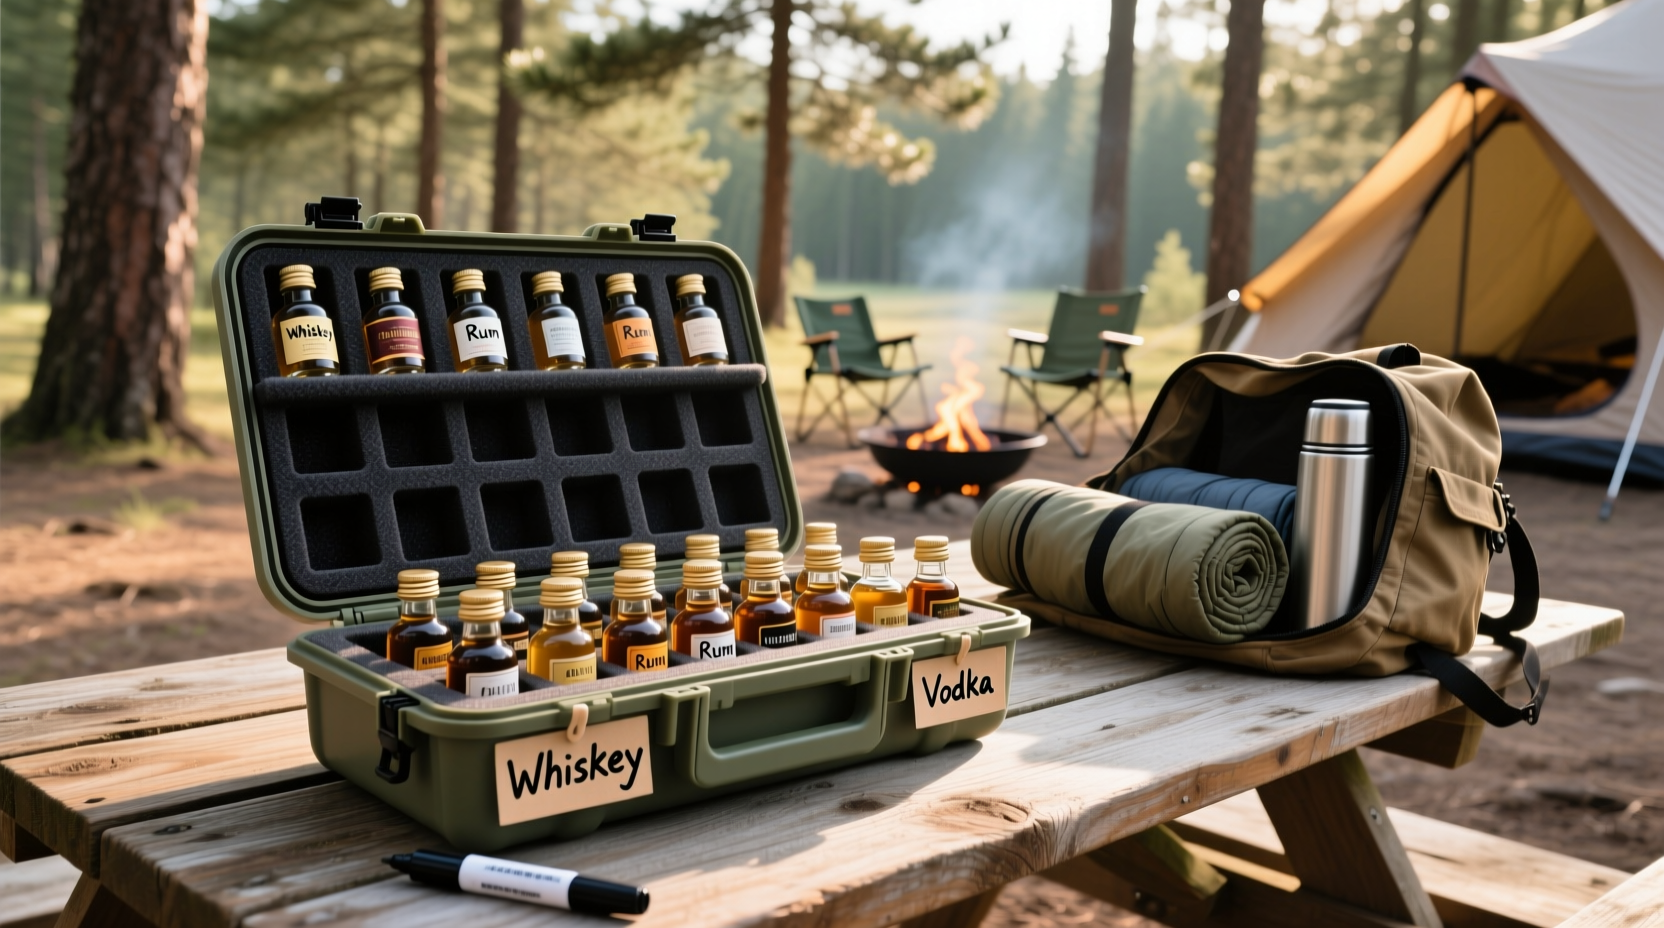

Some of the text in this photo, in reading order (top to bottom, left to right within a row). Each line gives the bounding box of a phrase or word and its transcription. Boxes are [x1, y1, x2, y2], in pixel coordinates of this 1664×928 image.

[466, 324, 500, 341] Rum
[700, 640, 733, 659] Rum
[922, 668, 994, 708] Vodka
[507, 742, 643, 800] Whiskey
